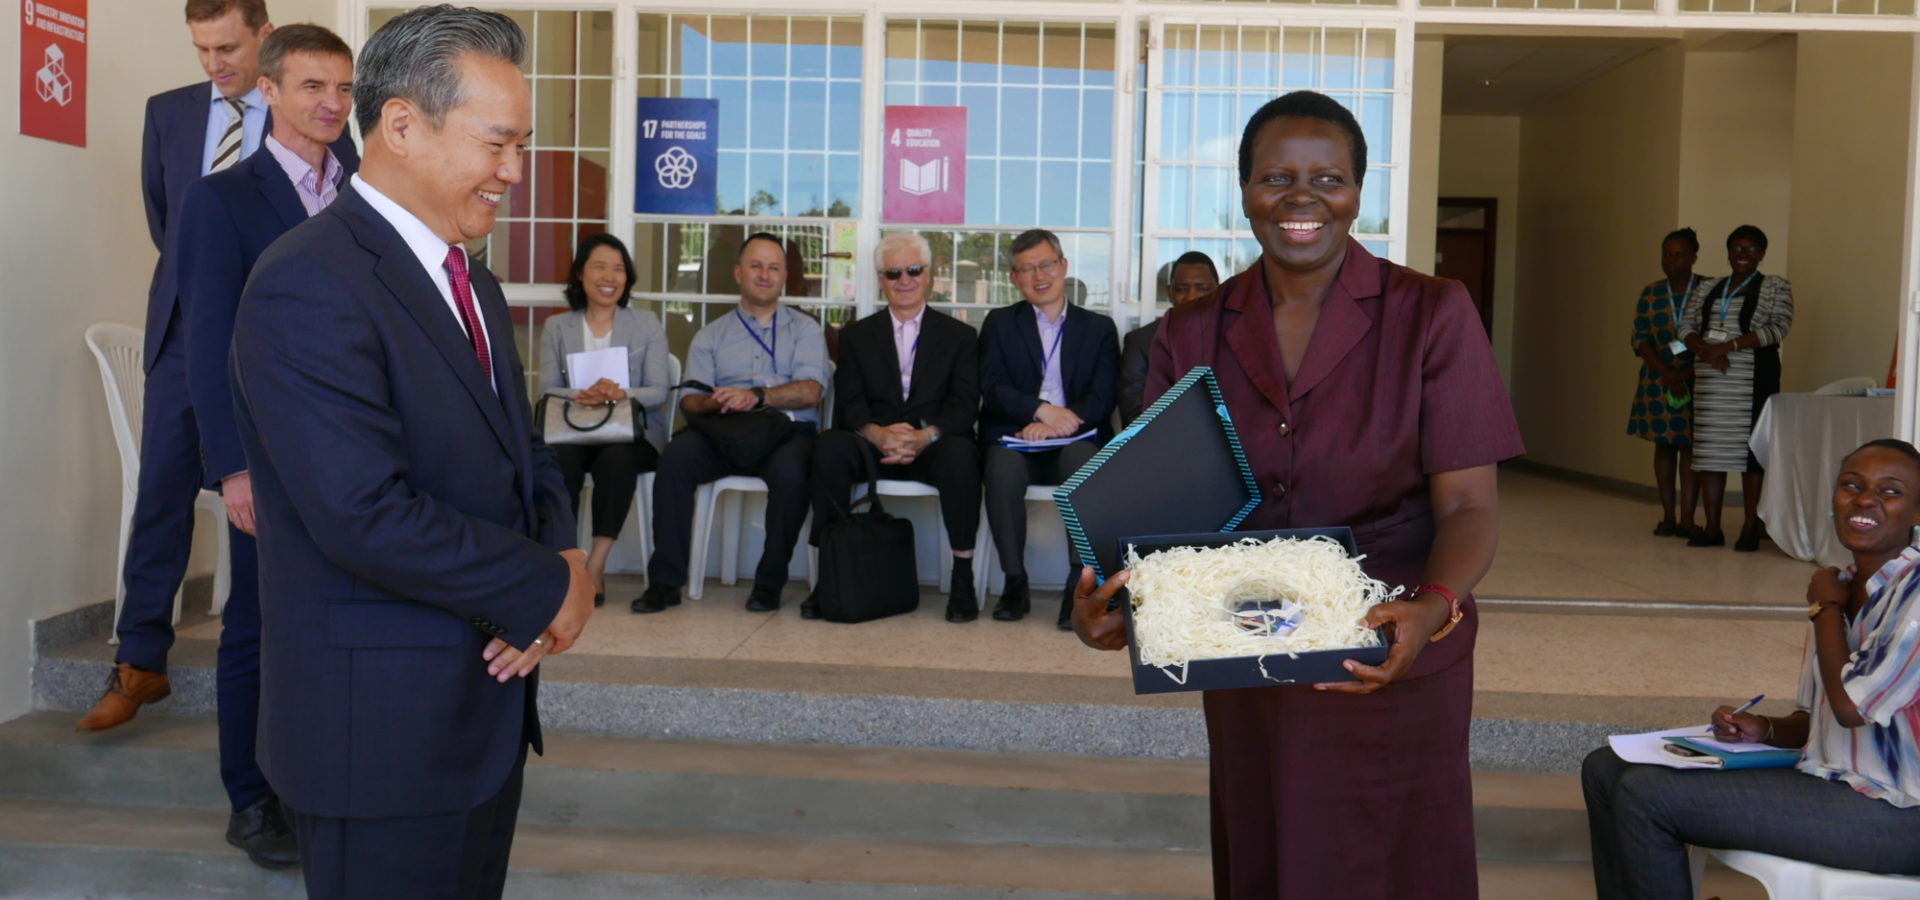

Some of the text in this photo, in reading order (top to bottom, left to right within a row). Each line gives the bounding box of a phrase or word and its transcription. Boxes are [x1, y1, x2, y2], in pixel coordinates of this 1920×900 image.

[25, 0, 33, 25] 9
[36, 18, 47, 31] AND
[59, 10, 85, 29] INNOVATION
[643, 120, 658, 139] 17
[661, 120, 706, 130] PARTNERSHIPS
[661, 130, 706, 140] FOR THE GOALS
[890, 128, 900, 147] 4
[906, 128, 932, 137] QUALITY
[906, 138, 940, 147] EDUCATION
